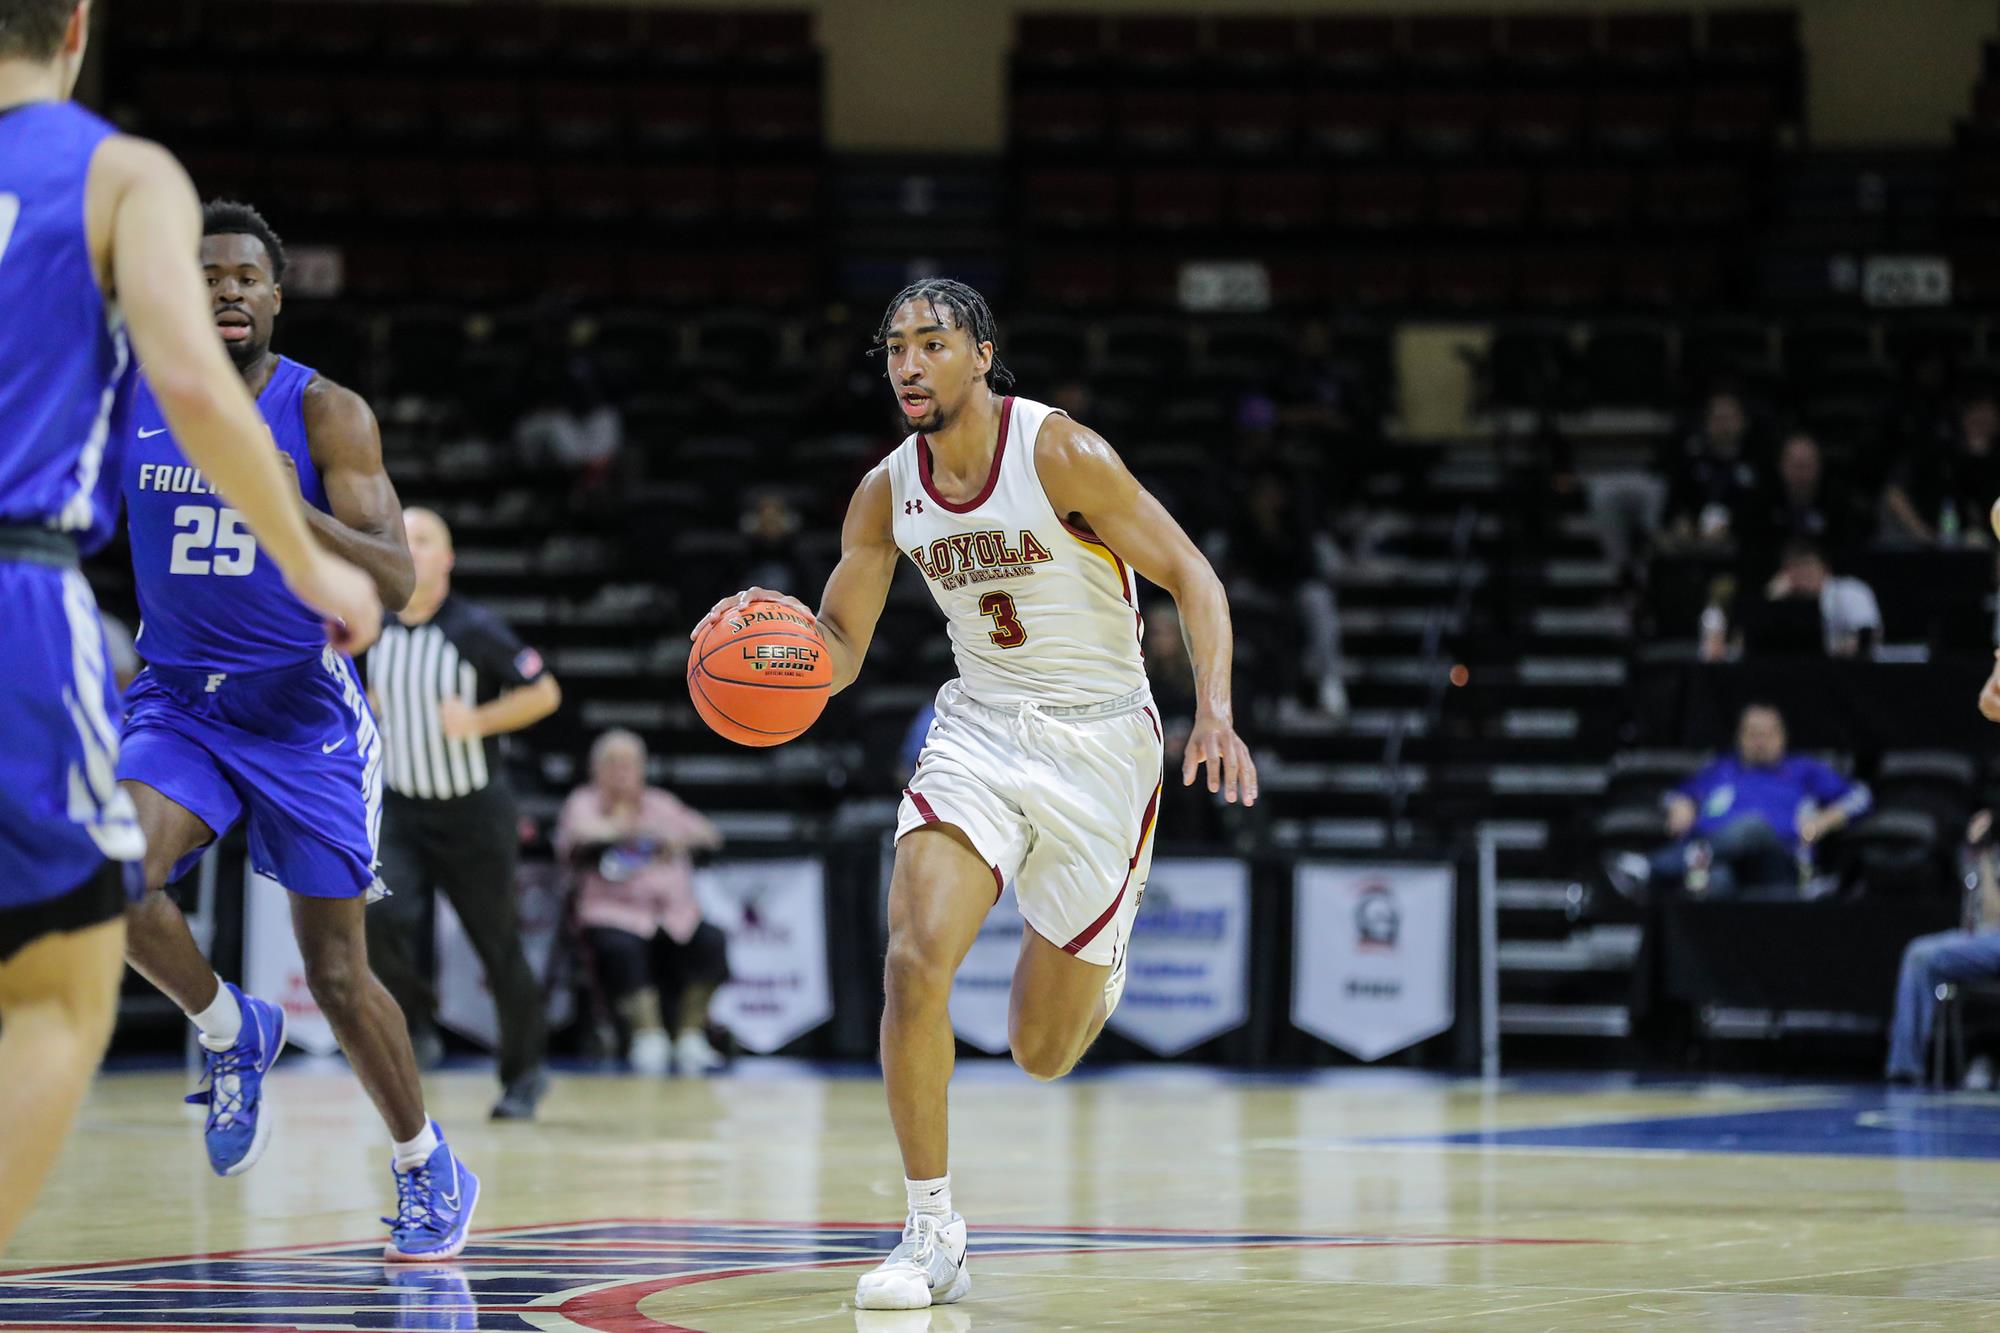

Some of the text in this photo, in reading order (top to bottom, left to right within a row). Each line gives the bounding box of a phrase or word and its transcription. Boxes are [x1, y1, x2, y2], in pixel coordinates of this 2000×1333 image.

[138, 463, 224, 495] FAUL
[170, 505, 256, 576] 25
[911, 530, 1053, 581] LOYOLA
[940, 565, 1035, 591] NEW ORLEANS
[979, 590, 1027, 649] 3
[742, 645, 819, 662] LEGACY
[204, 674, 227, 693] F
